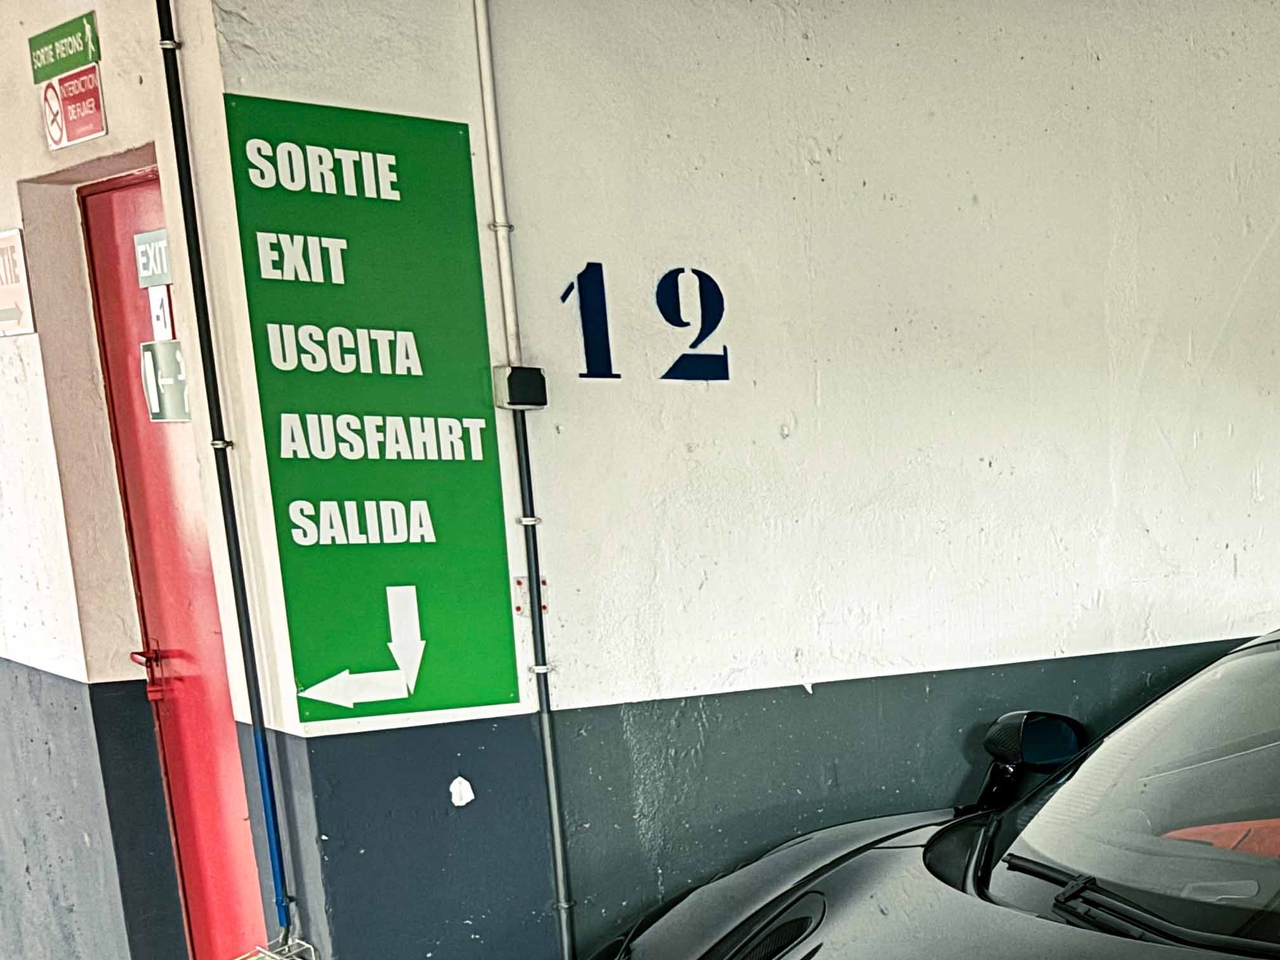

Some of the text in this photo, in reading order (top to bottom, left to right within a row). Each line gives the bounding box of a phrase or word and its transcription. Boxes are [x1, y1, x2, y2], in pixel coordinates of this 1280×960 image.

[245, 138, 400, 201] SORTIE
[137, 243, 168, 277] EXIT
[255, 231, 347, 285] EXIT
[560, 261, 730, 381] 12
[267, 323, 423, 376] USCITA
[280, 413, 486, 461] AUSFAHRT
[288, 500, 437, 546] SALIDA
